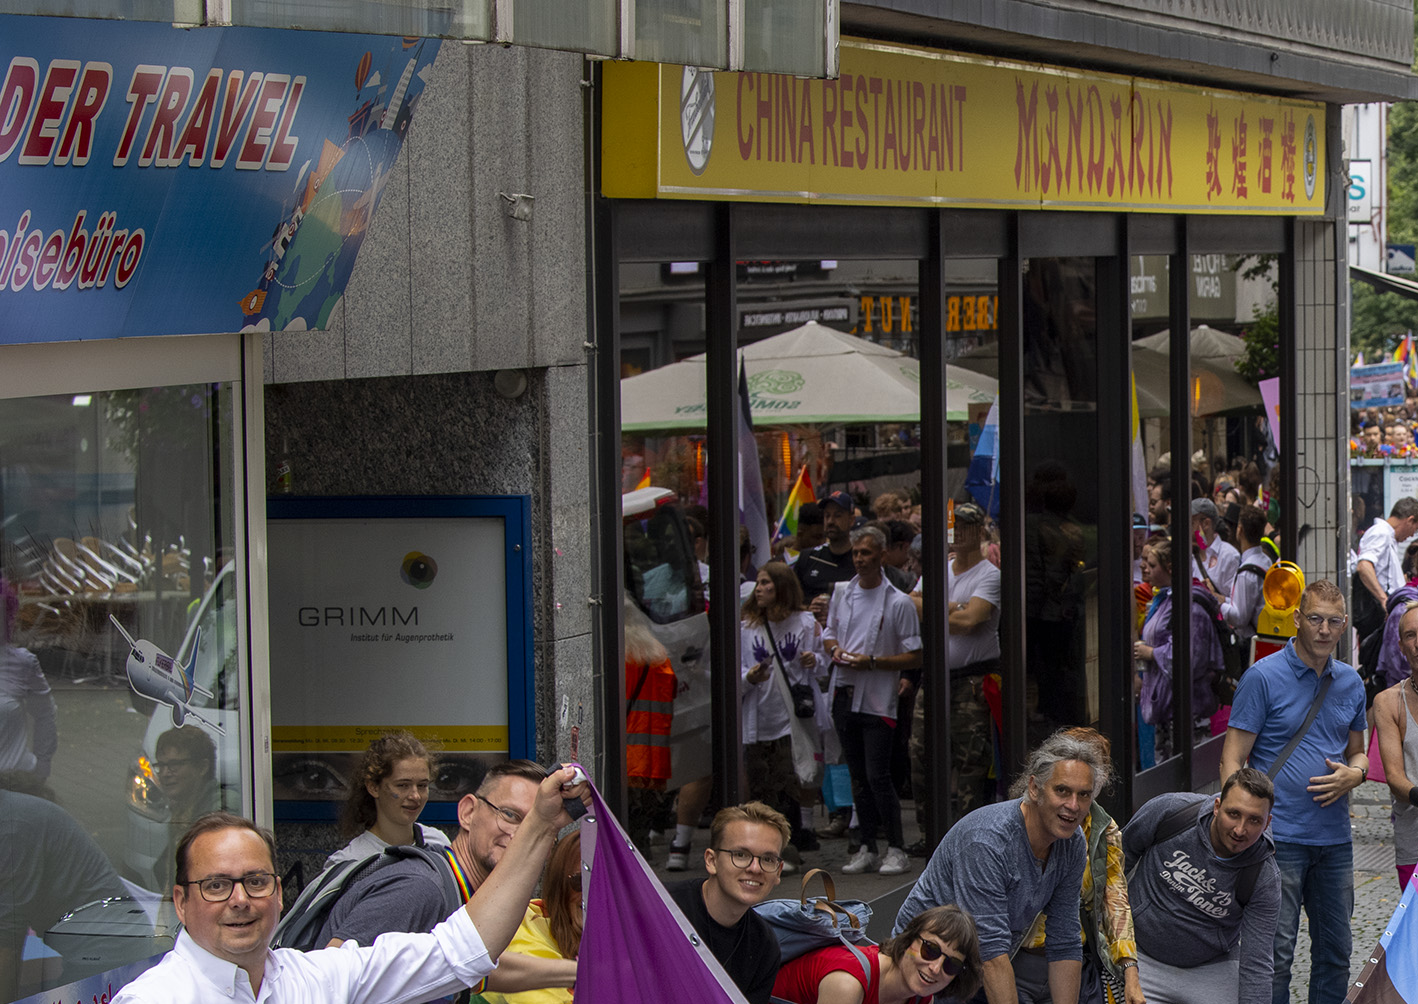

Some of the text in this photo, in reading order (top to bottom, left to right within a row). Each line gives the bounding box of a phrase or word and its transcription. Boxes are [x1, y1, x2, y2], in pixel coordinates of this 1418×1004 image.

[113, 65, 307, 171] TRAVEL
[737, 71, 815, 165] CHINA
[823, 73, 966, 172] RESTAURANT
[1014, 76, 1173, 200] MANDARIN
[1206, 100, 1298, 204] 敦煌酒樓
[299, 606, 419, 627] GRIMM
[350, 633, 454, 644] Institut für Augenprothetik
